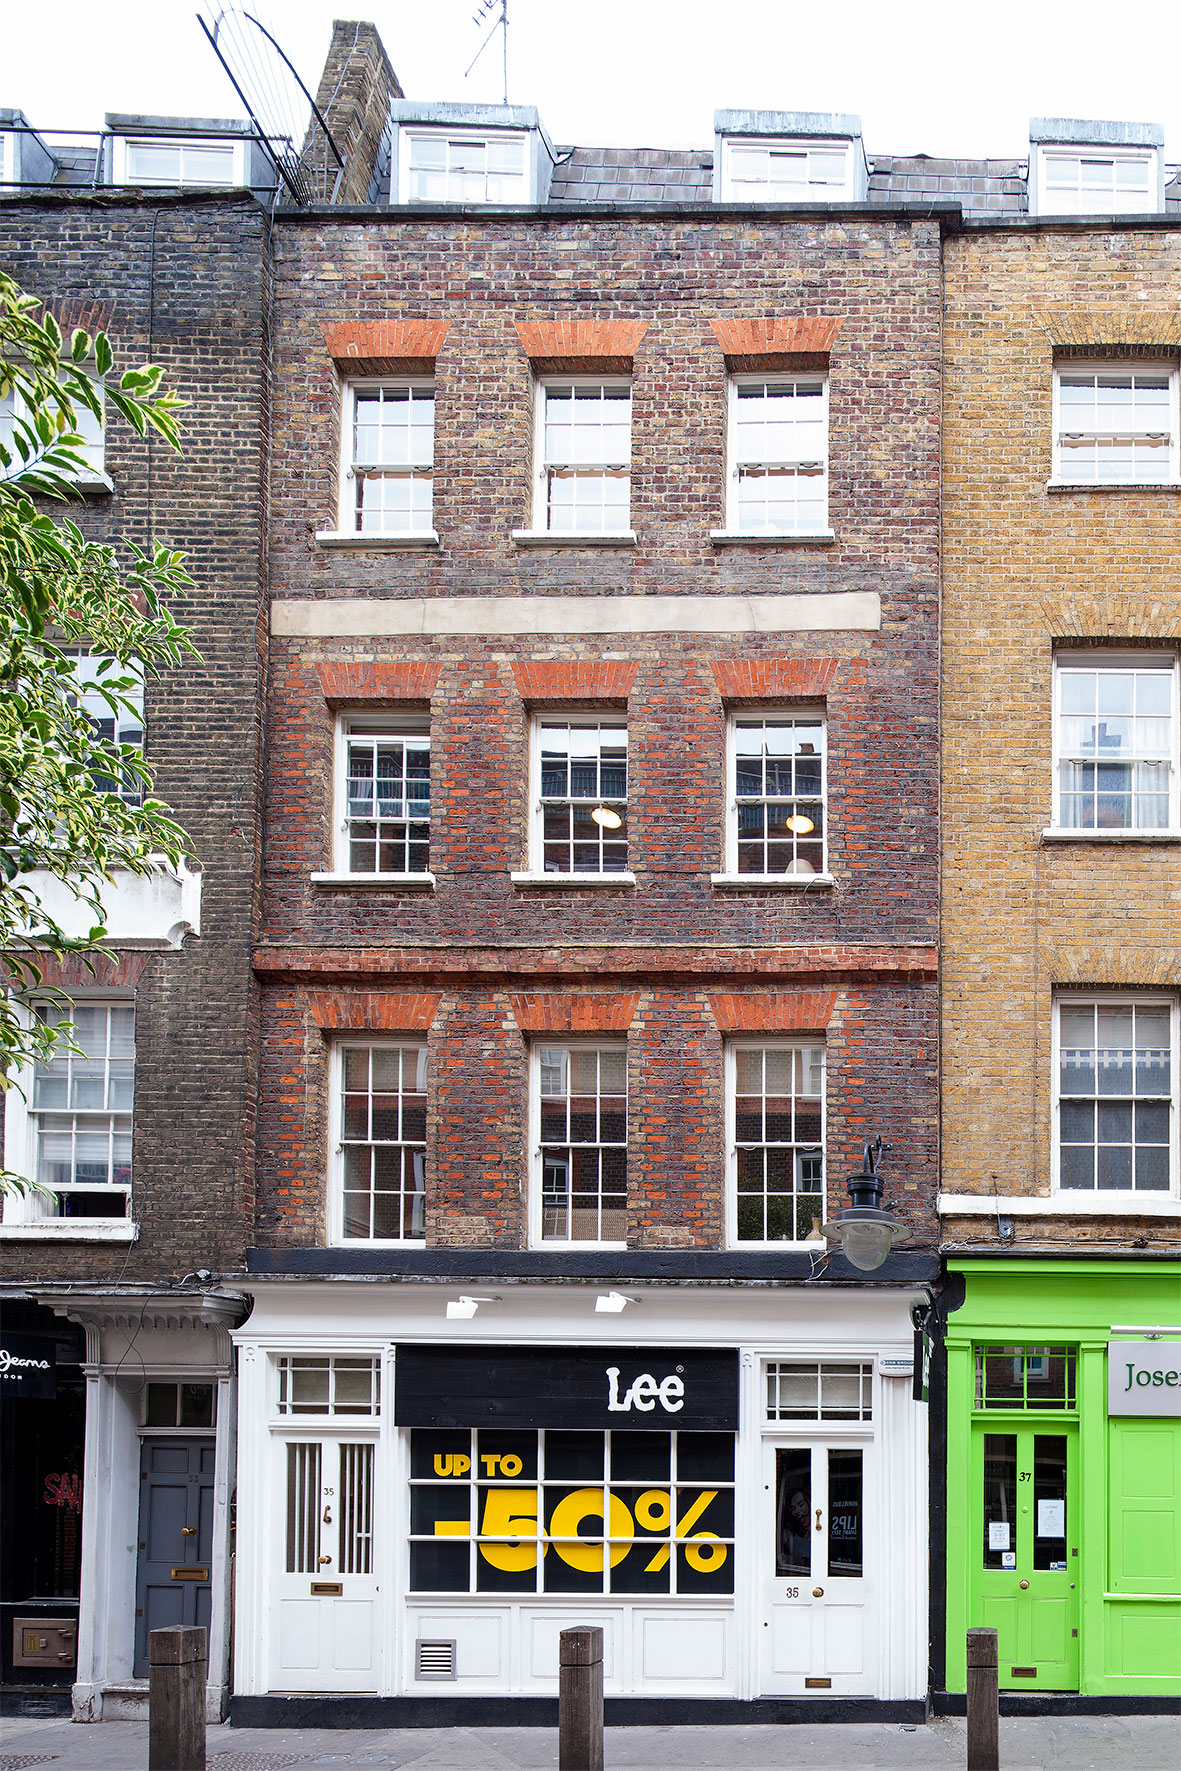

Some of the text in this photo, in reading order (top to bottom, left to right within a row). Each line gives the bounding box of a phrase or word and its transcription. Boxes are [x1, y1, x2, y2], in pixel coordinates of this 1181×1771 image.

[0, 1350, 50, 1371] Jeans
[1125, 1363, 1181, 1391] Jose
[606, 1367, 684, 1412] Lee
[434, 1454, 523, 1477] UP TO
[1019, 1472, 1031, 1482] 37
[434, 1488, 727, 1573] -50%
[786, 1587, 799, 1598] 35
